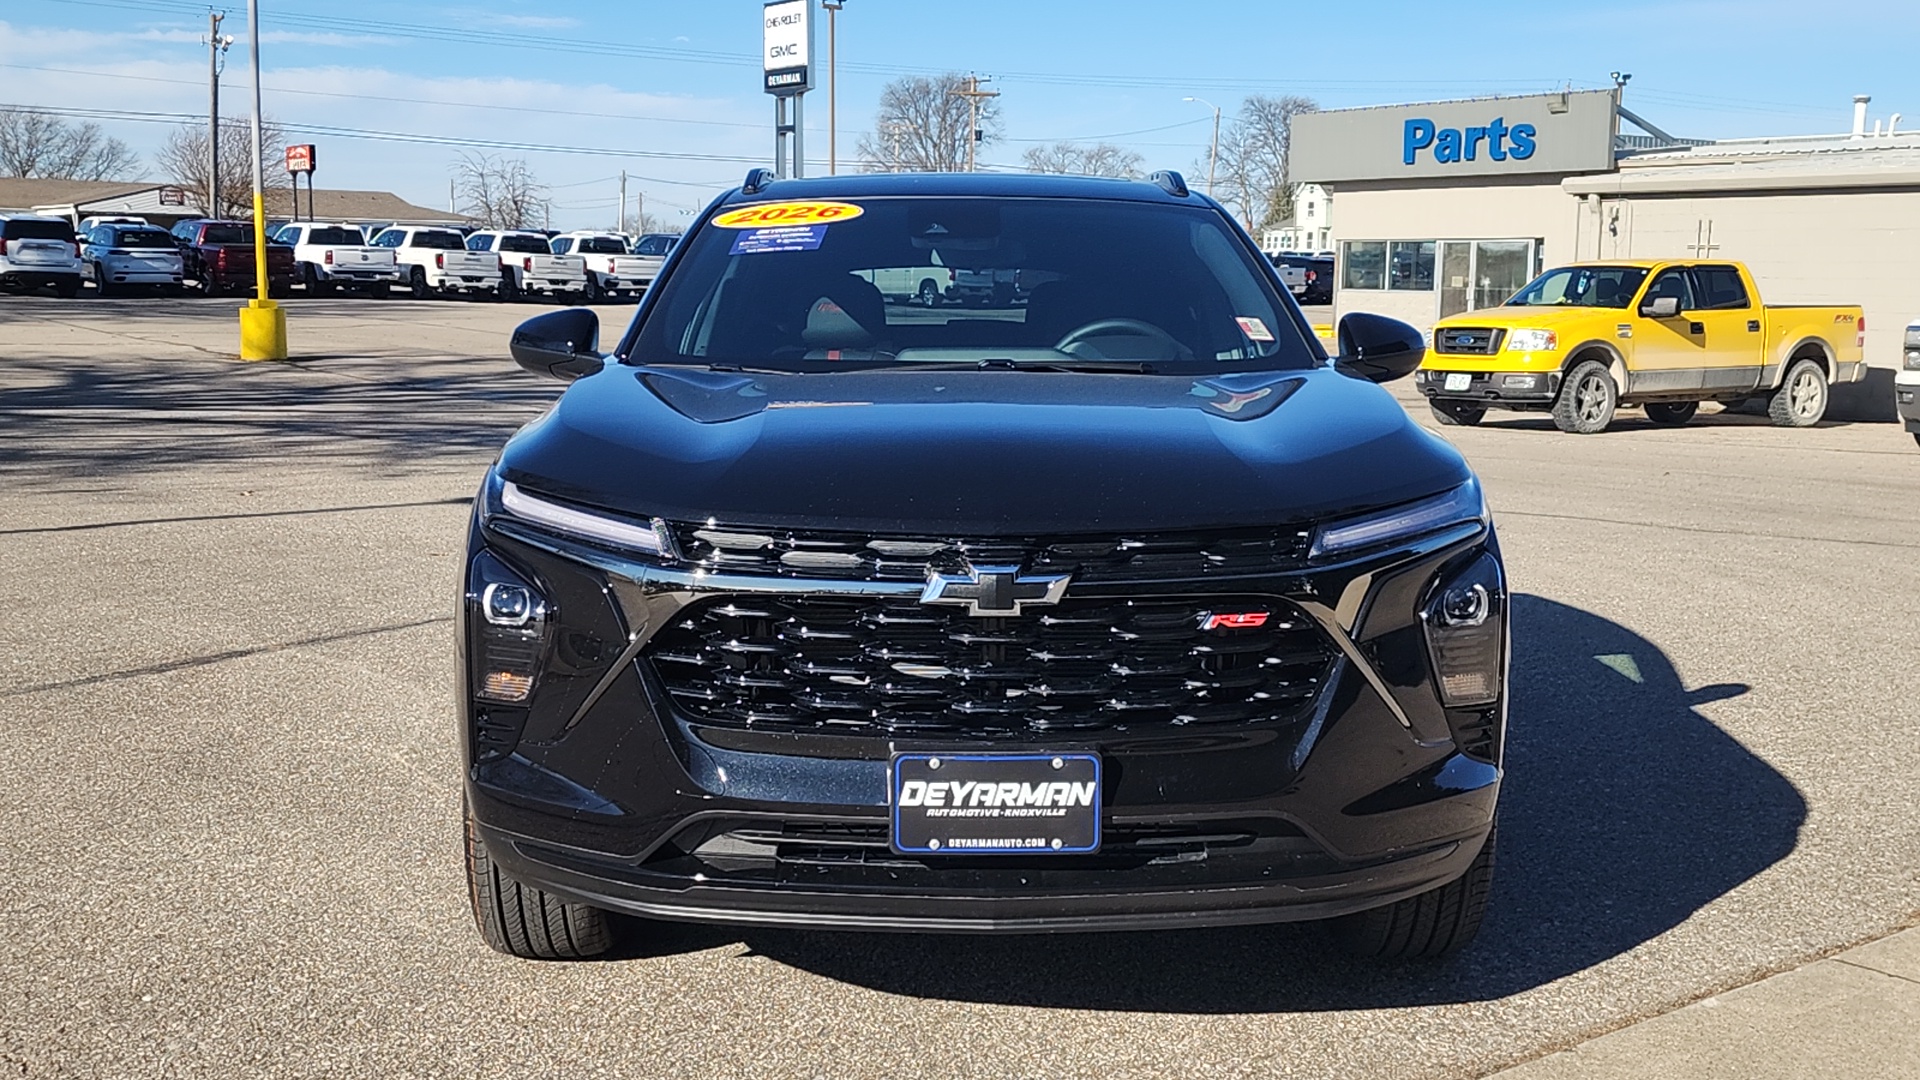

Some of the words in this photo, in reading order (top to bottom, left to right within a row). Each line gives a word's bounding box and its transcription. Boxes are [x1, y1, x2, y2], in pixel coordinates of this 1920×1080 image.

[766, 13, 801, 28] CHEVROLET
[770, 43, 797, 58] GMC
[1403, 117, 1536, 165] Parts
[726, 207, 847, 225] 2026
[1210, 612, 1270, 629] RS
[899, 781, 1096, 807] DEYARMAN
[948, 838, 1046, 848] DEYARMANAUTO.COM
